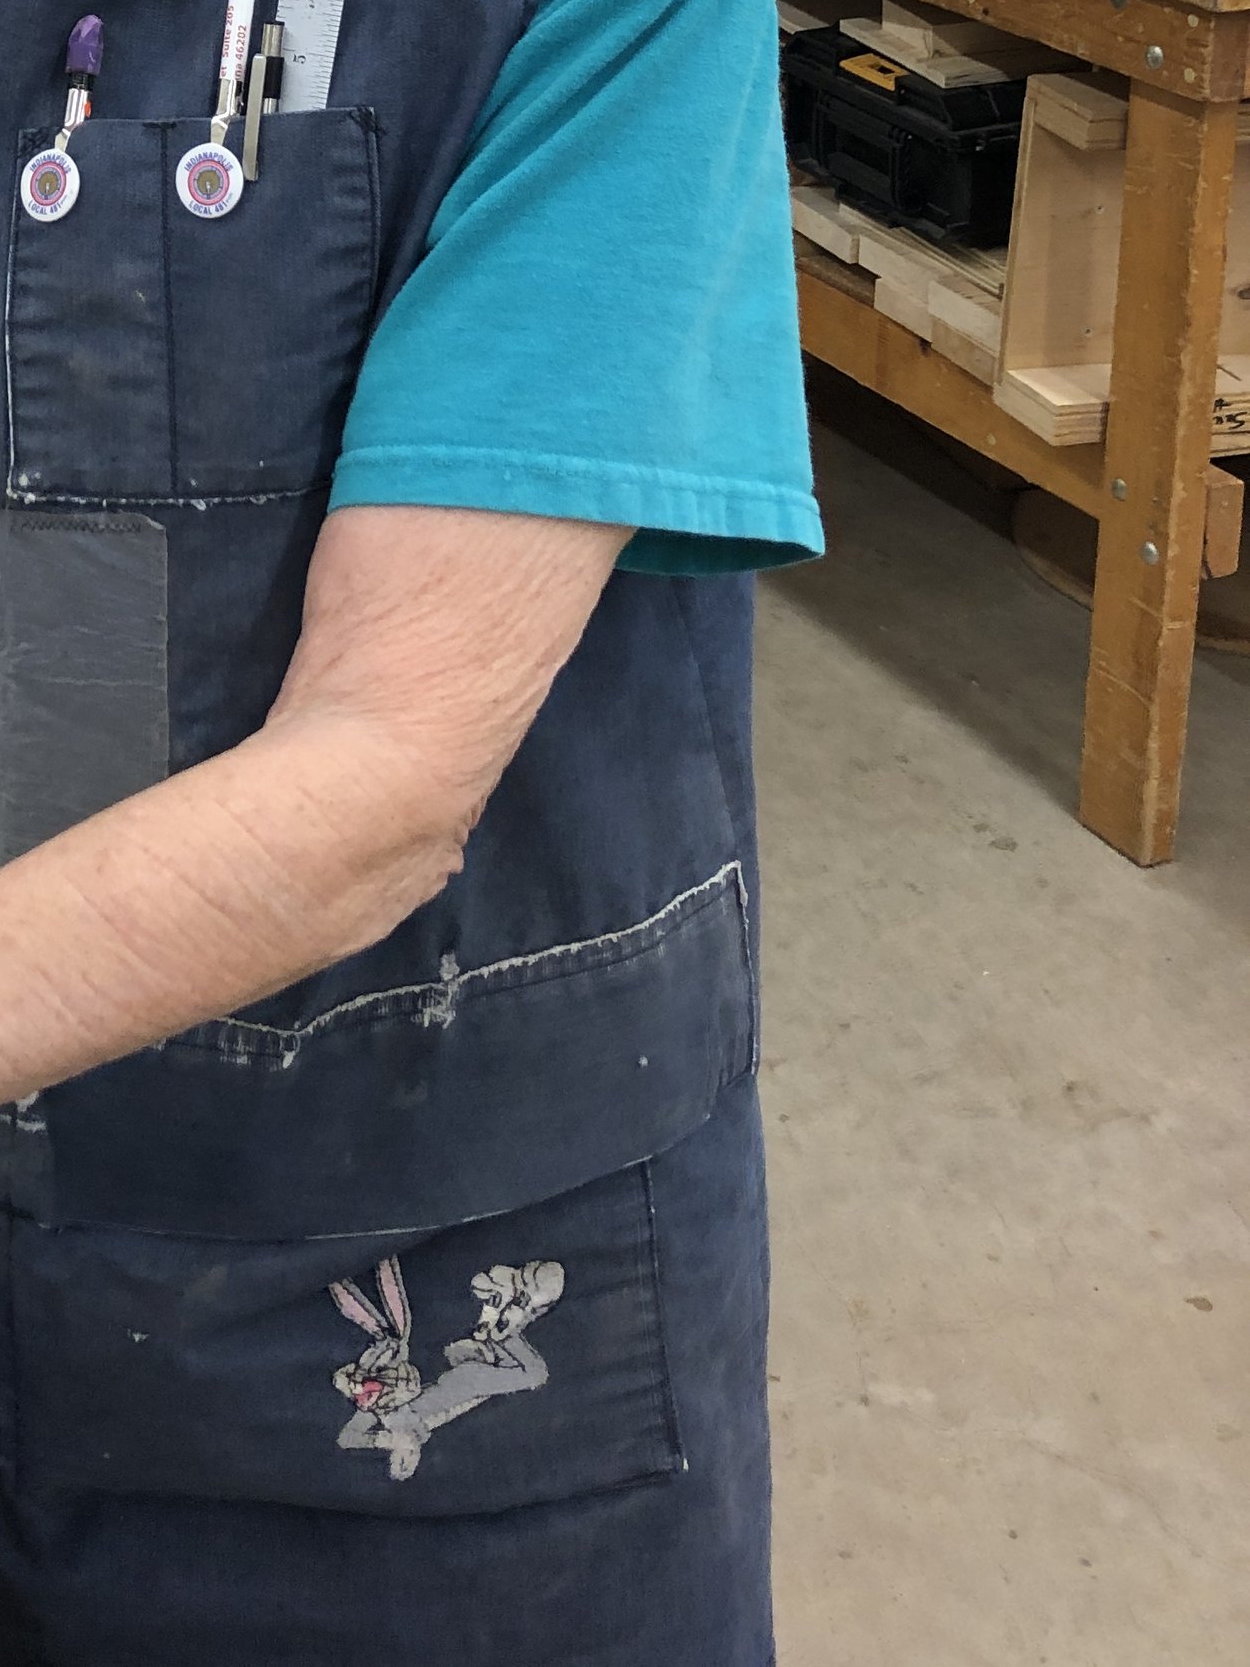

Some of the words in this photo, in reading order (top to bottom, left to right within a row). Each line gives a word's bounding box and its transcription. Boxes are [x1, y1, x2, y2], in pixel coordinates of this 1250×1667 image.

[235, 25, 247, 61] 46202
[293, 53, 306, 65] 5
[30, 153, 71, 174] INDIANAPOLIS
[184, 151, 234, 172] INDIANAPOLIS
[28, 200, 48, 215] LOCAL
[189, 200, 213, 215] LOCAL
